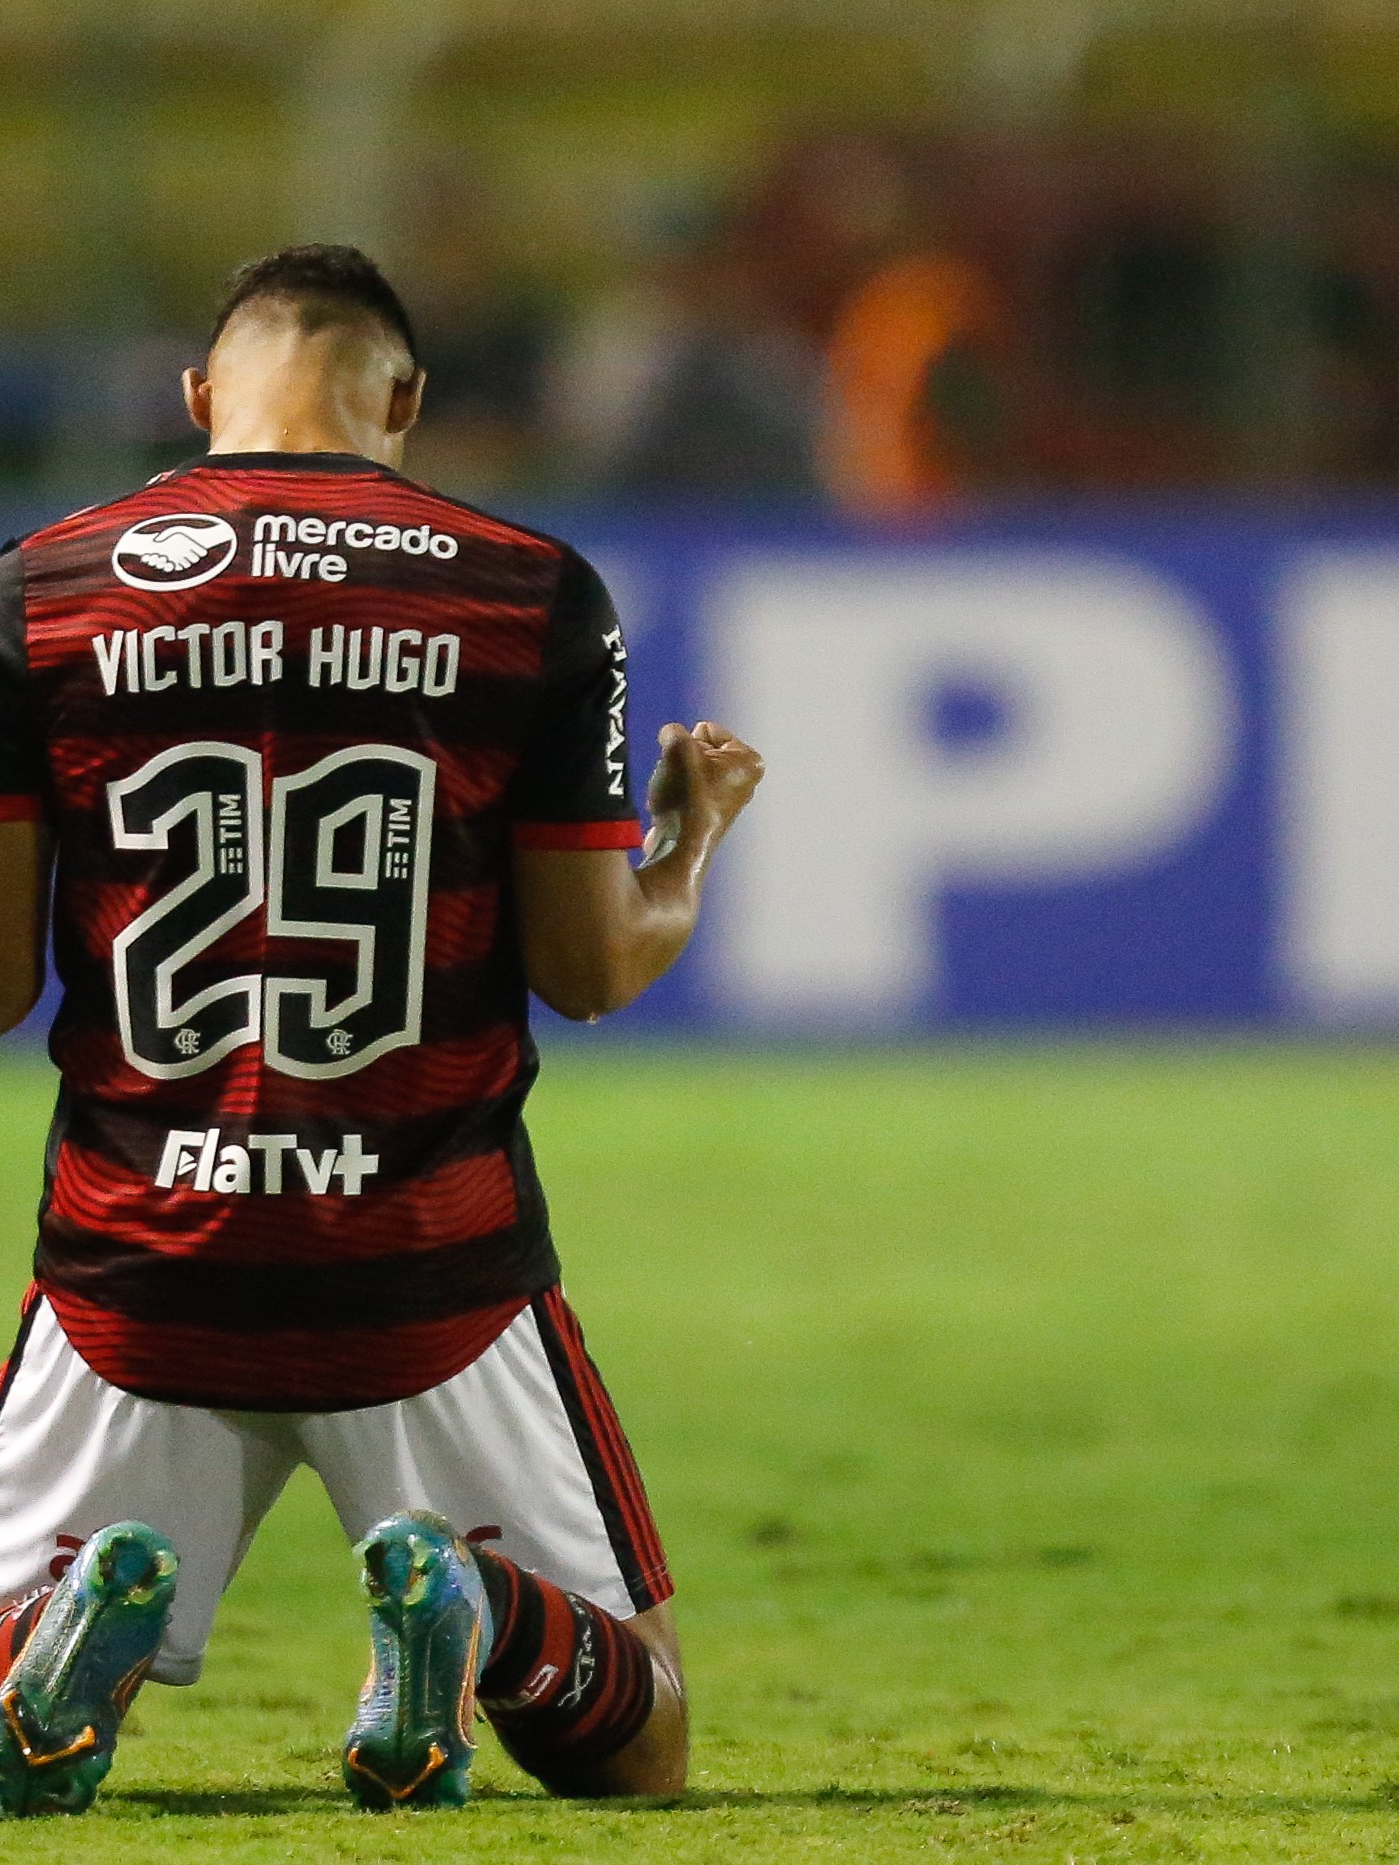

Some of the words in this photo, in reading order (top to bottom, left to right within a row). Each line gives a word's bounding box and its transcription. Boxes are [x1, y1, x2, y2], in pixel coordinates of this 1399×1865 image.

[252, 514, 459, 560] mercado
[252, 542, 348, 582] livre
[92, 620, 284, 696] VICTOR
[308, 624, 461, 697] HUGO
[218, 793, 243, 844] TIM
[387, 798, 413, 849] TIM
[106, 740, 437, 1081] 29
